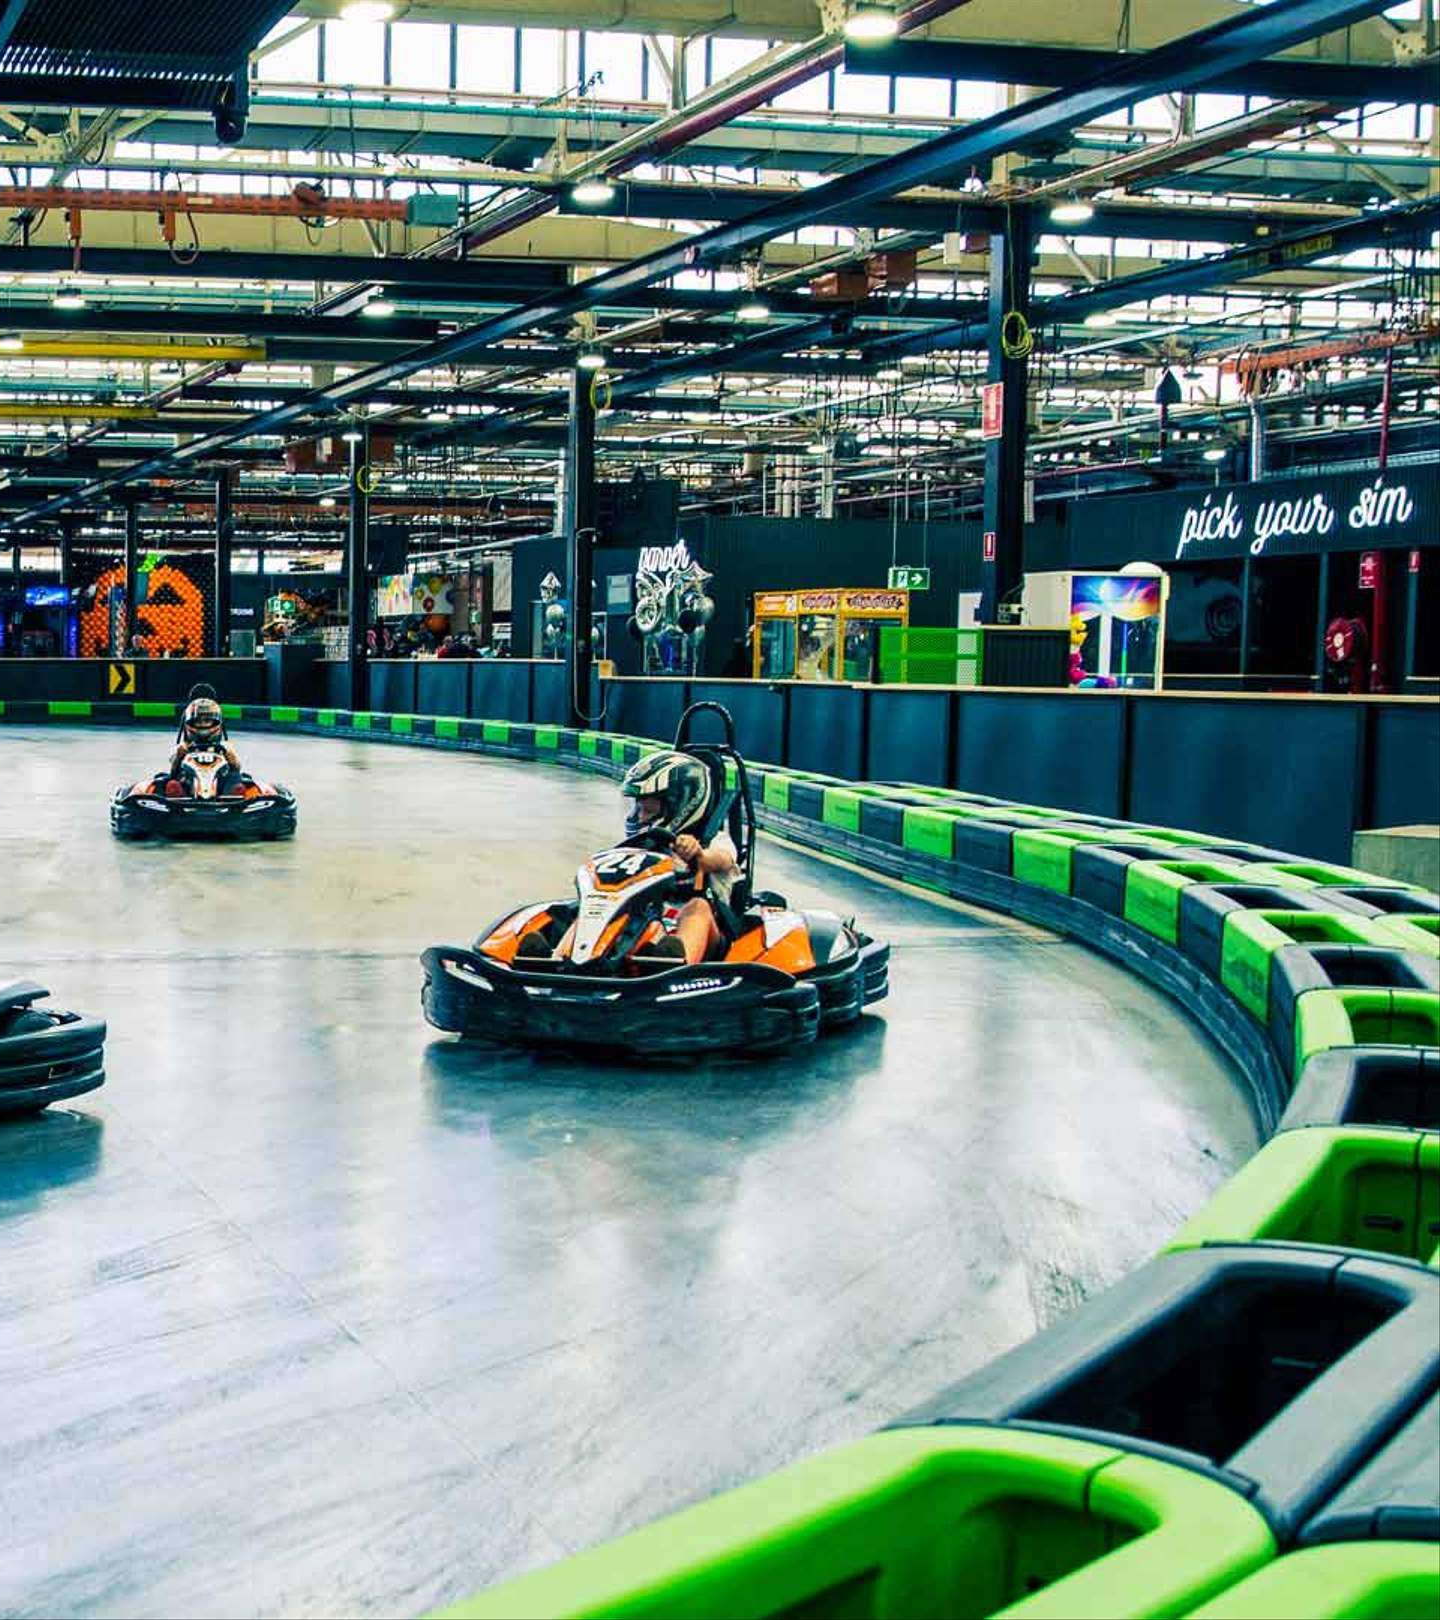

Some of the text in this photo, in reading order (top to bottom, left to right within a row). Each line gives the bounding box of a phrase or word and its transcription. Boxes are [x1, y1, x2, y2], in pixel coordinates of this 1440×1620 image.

[1175, 475, 1414, 560] pick your sim
[596, 852, 647, 875] 24
